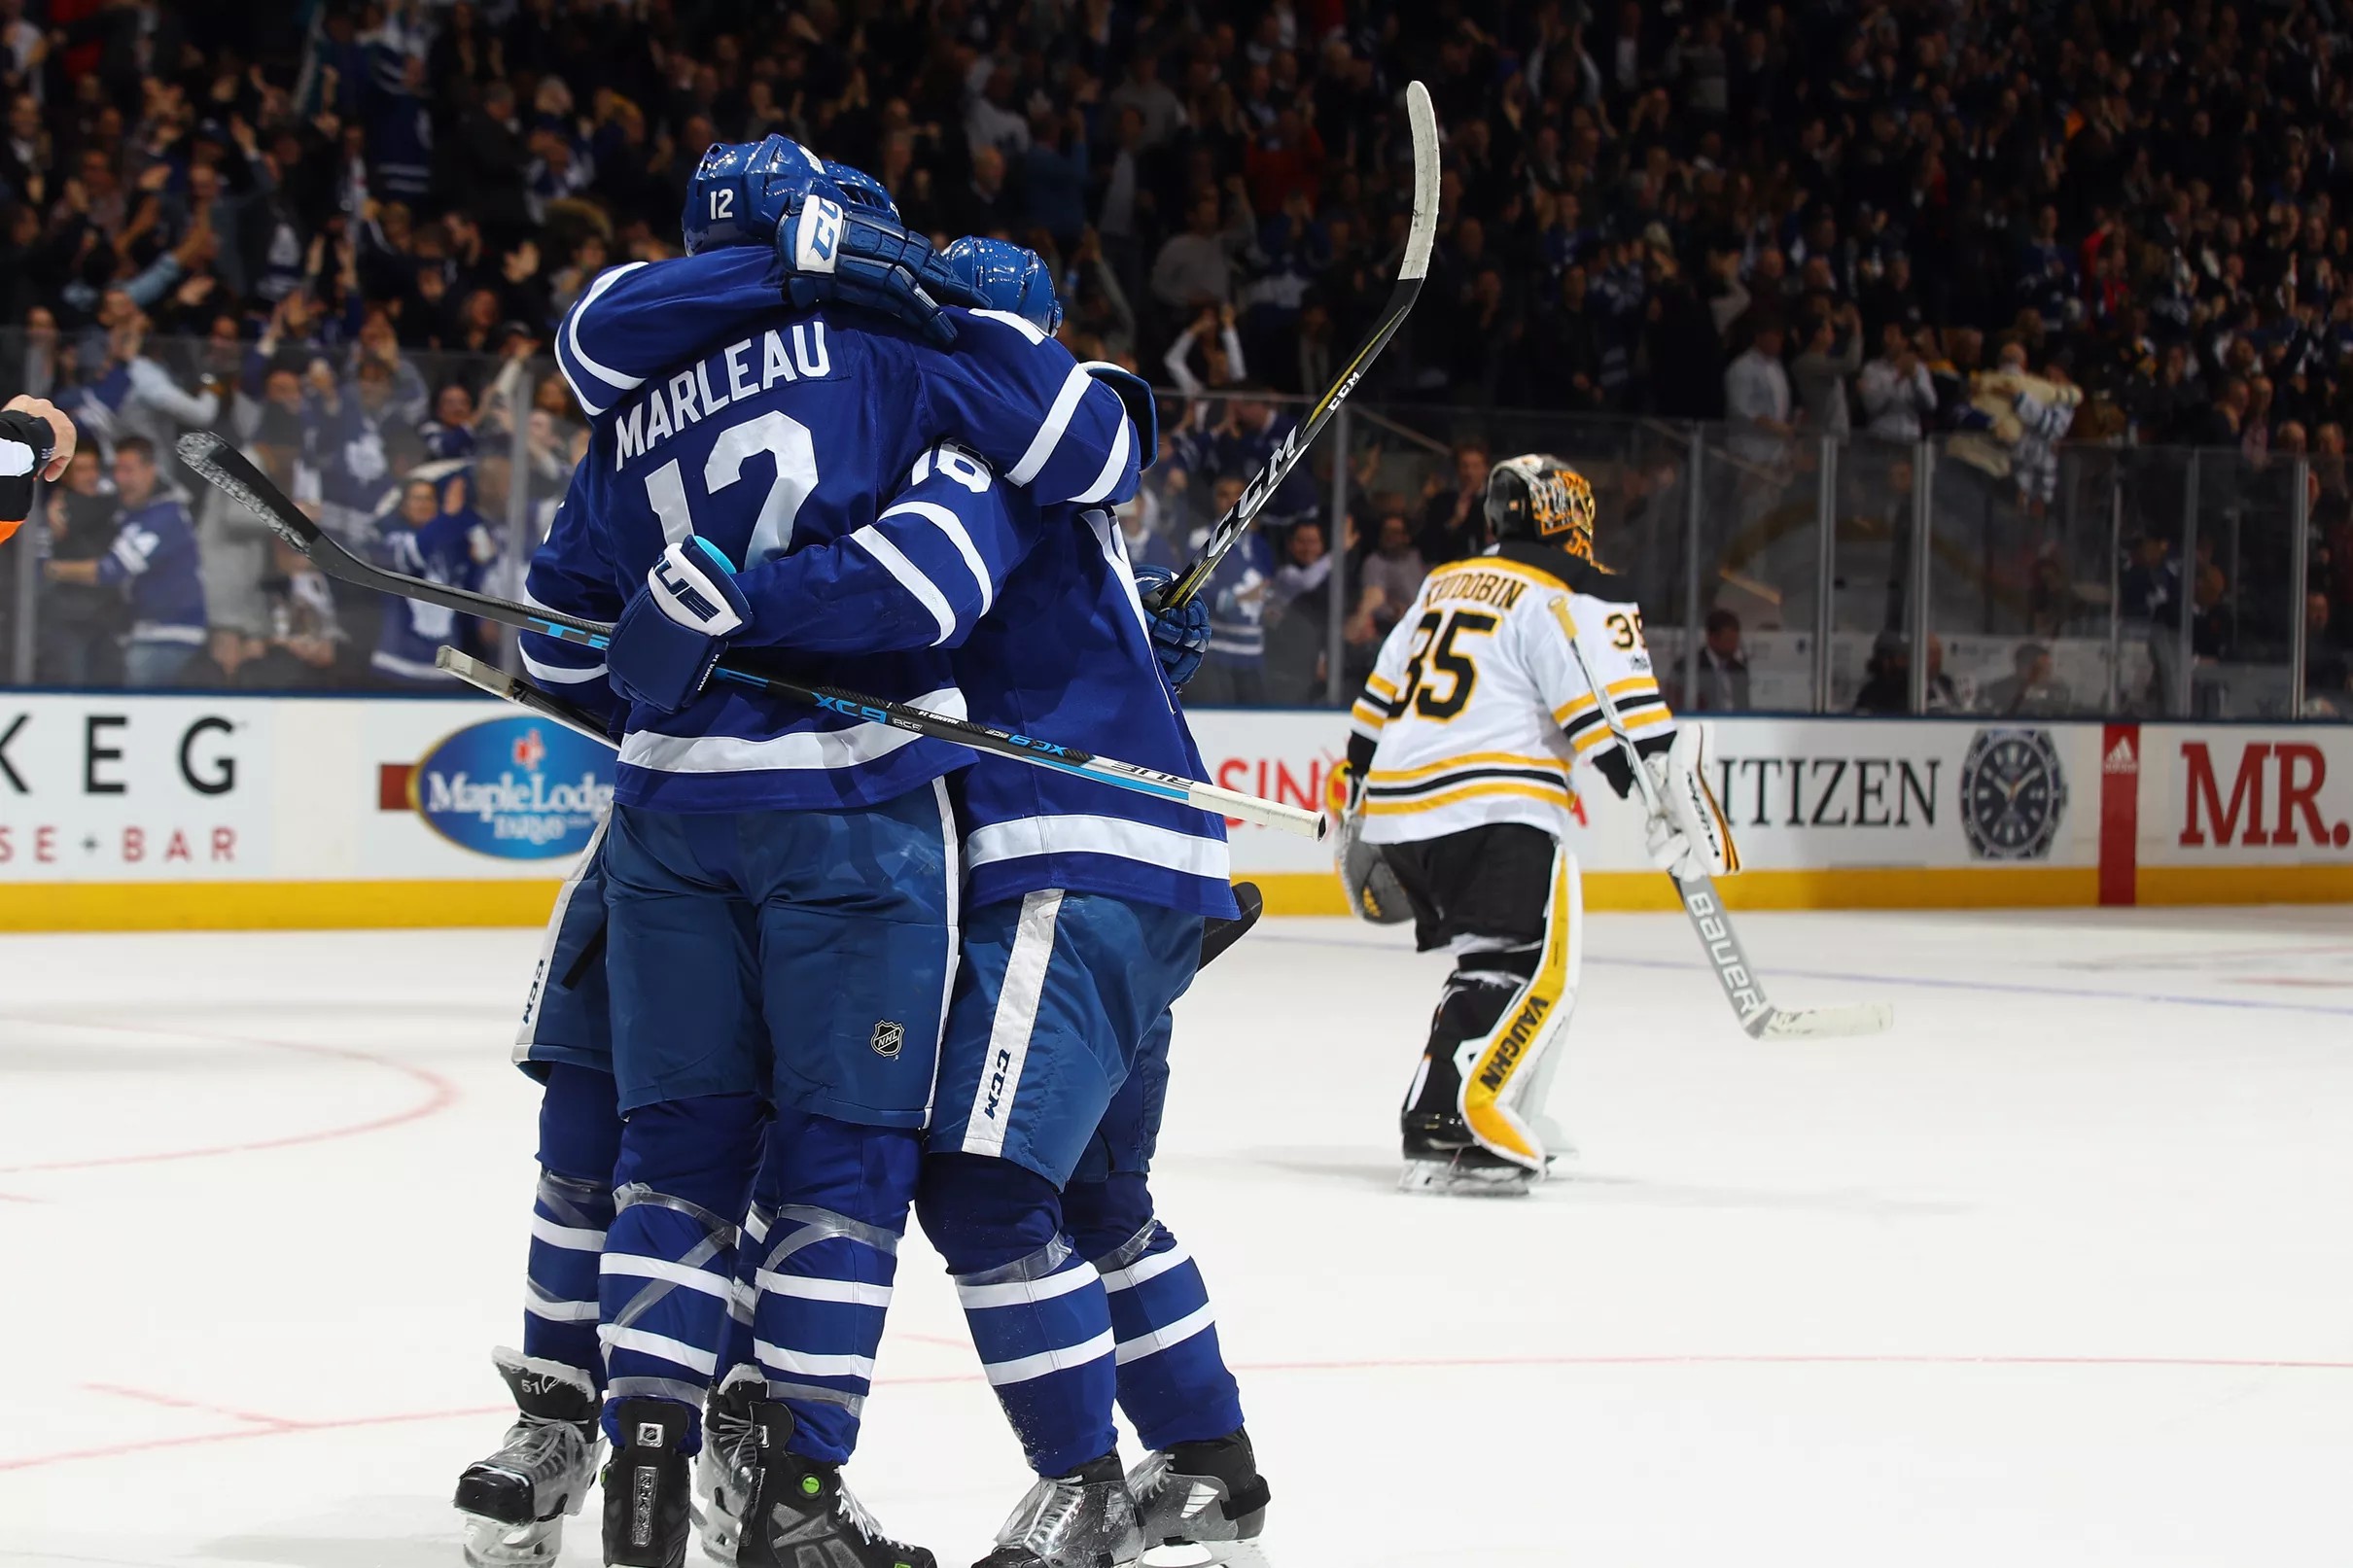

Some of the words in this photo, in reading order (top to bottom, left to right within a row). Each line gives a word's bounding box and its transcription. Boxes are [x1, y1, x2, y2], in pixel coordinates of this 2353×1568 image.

[710, 189, 734, 220] 12
[615, 320, 831, 472] MARLEAU
[1327, 371, 1360, 411] CCM
[644, 409, 819, 572] 12
[1207, 425, 1297, 557] CCM
[697, 664, 715, 691] MARNER
[1387, 609, 1503, 723] 35
[811, 691, 887, 724] XC9
[928, 713, 960, 724] MARNER
[0, 714, 236, 795] KEG
[1110, 761, 1195, 788] RUE
[1716, 757, 1941, 827] ITIZEN
[2178, 742, 2350, 849] MR.
[123, 826, 236, 863] BAR
[522, 958, 545, 1024] CCM
[877, 1030, 899, 1048] NHL
[1480, 995, 1550, 1093] VAUGHN
[984, 1049, 1011, 1120] CCM
